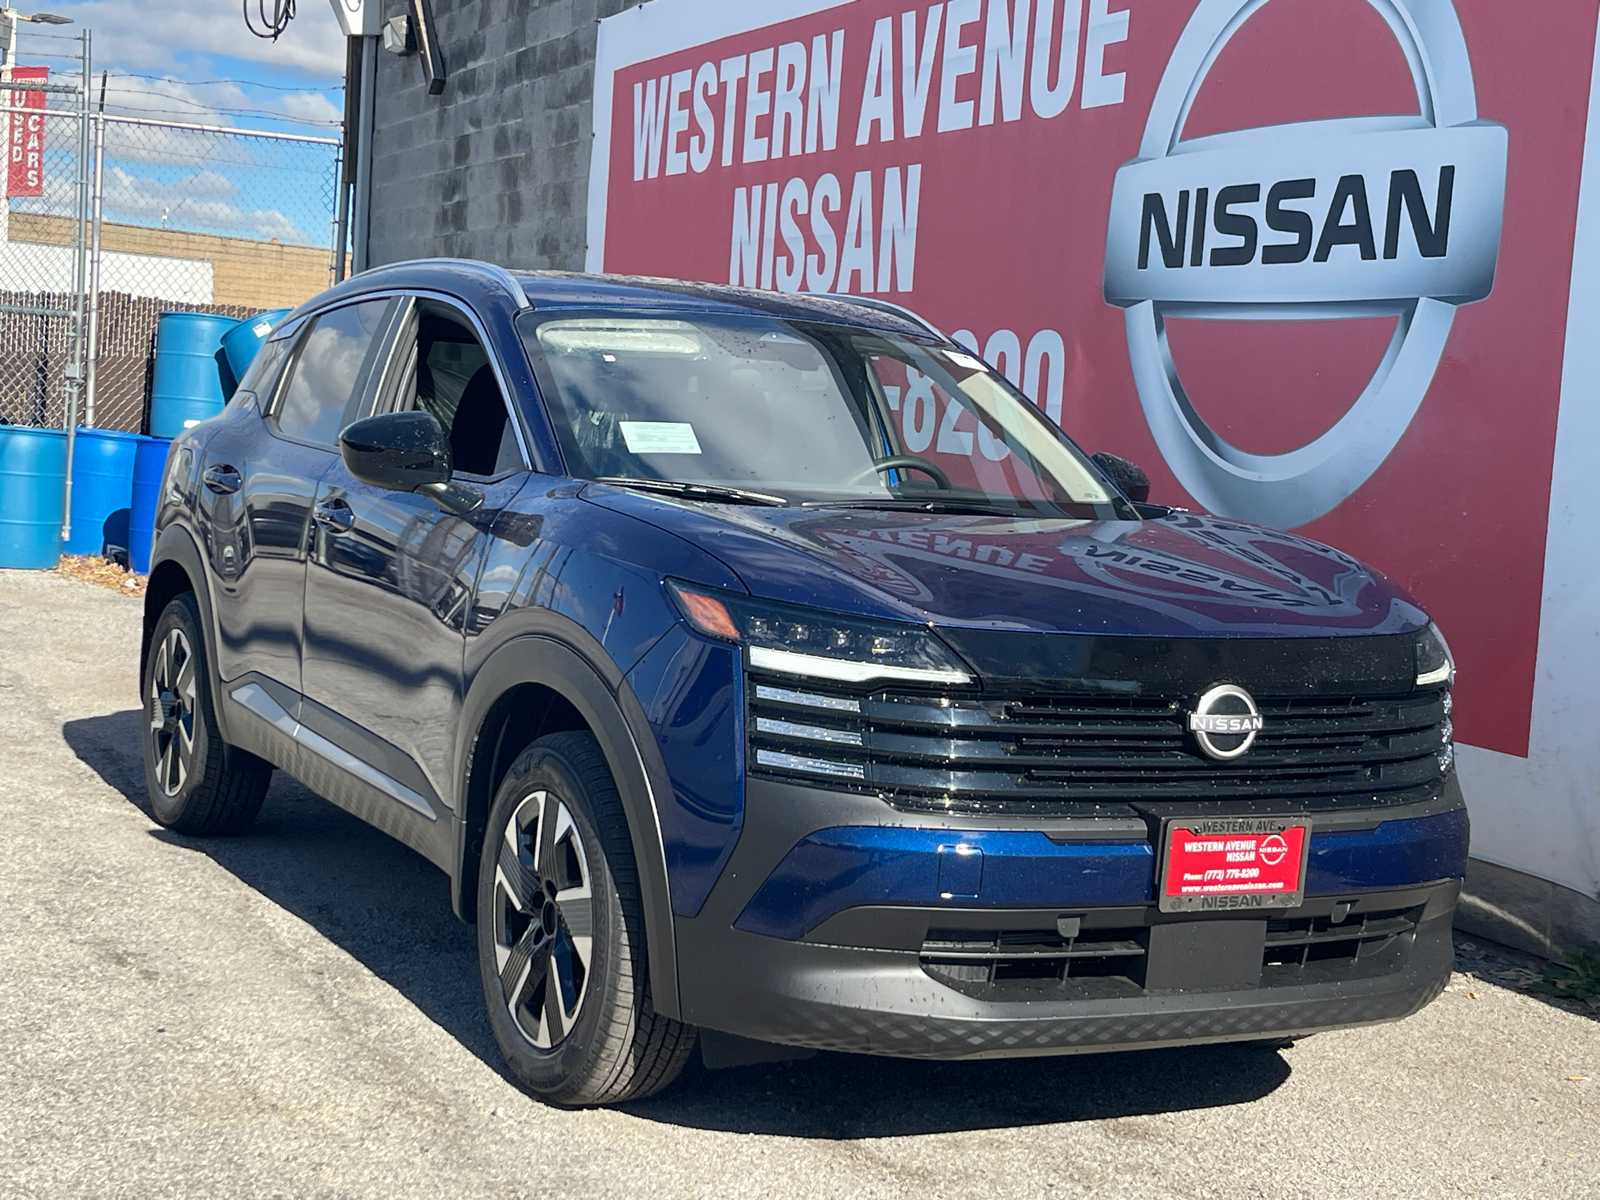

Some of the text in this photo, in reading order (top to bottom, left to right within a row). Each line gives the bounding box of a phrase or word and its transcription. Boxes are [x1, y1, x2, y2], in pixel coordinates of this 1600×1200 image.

[633, 0, 1130, 182] WESTERN AVENUE
[12, 91, 26, 162] USED
[26, 115, 41, 187] CARS
[1137, 165, 1455, 270] NISSAN
[729, 163, 922, 293] NISSAN
[1192, 716, 1263, 731] NISSAN
[1202, 820, 1253, 832] WESTERN
[1184, 840, 1257, 852] WESTERN AVENUE
[1226, 851, 1255, 863] NISSAN
[1204, 869, 1225, 882] (773)
[1225, 868, 1260, 880] 776-8200
[1201, 894, 1262, 908] NISSAN
